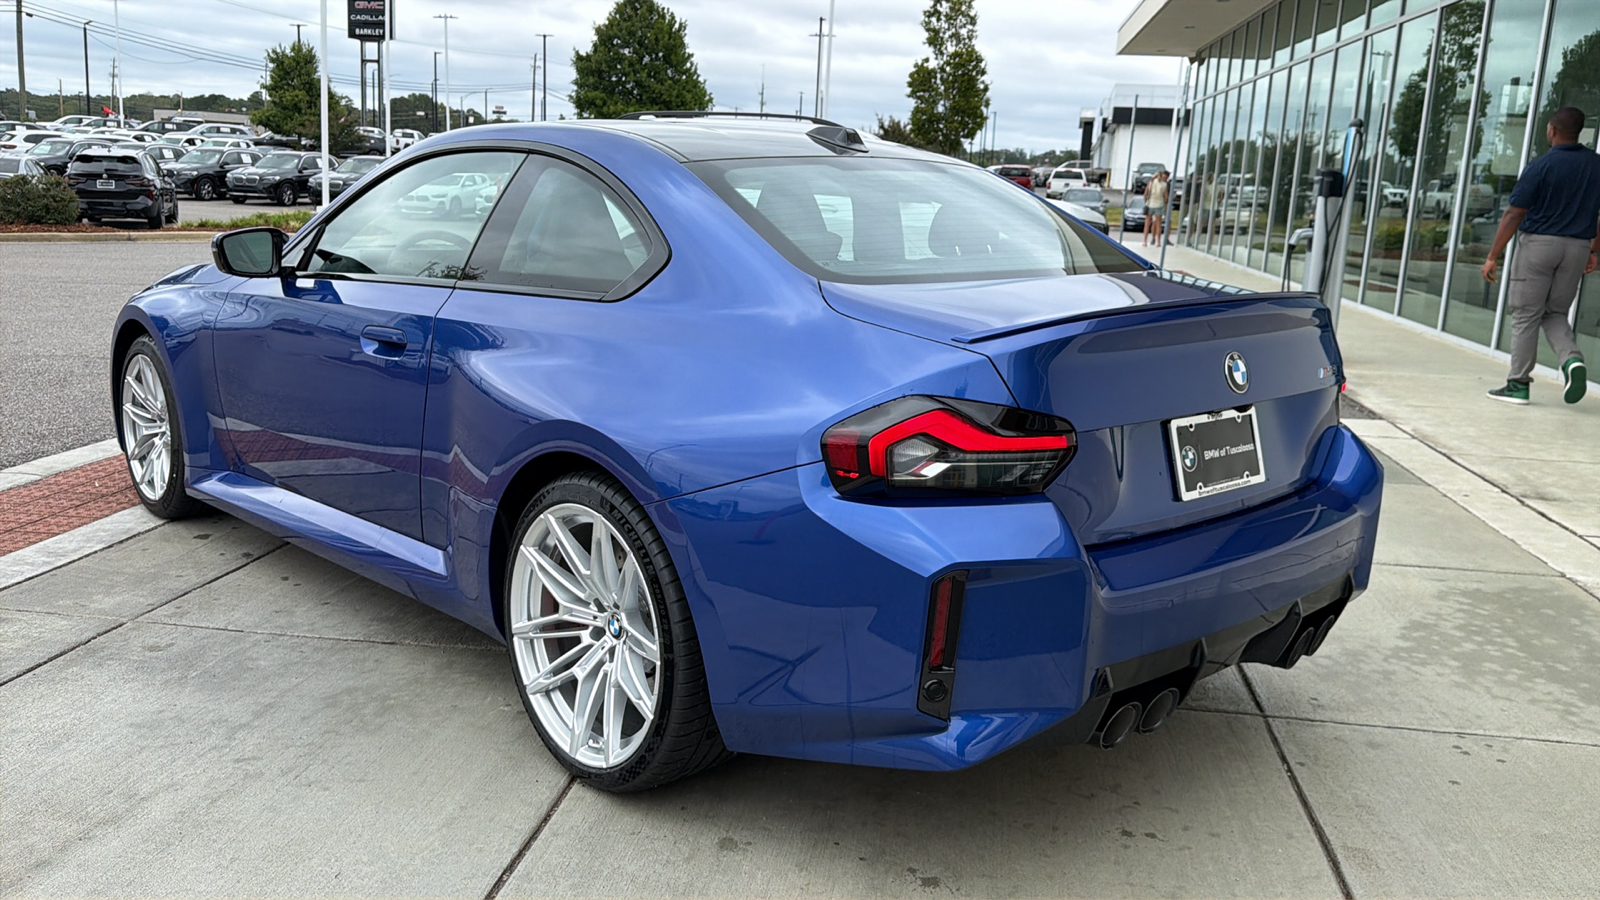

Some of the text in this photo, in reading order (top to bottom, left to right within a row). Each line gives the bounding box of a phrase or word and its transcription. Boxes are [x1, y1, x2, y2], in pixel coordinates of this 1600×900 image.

[354, 1, 384, 9] GMC
[355, 28, 384, 36] BARKLEY
[1203, 442, 1255, 460] BMW of Tuscaloosa
[1198, 479, 1252, 496] bmwoftuscaloosa.com
[611, 508, 656, 579] MICHELIN
